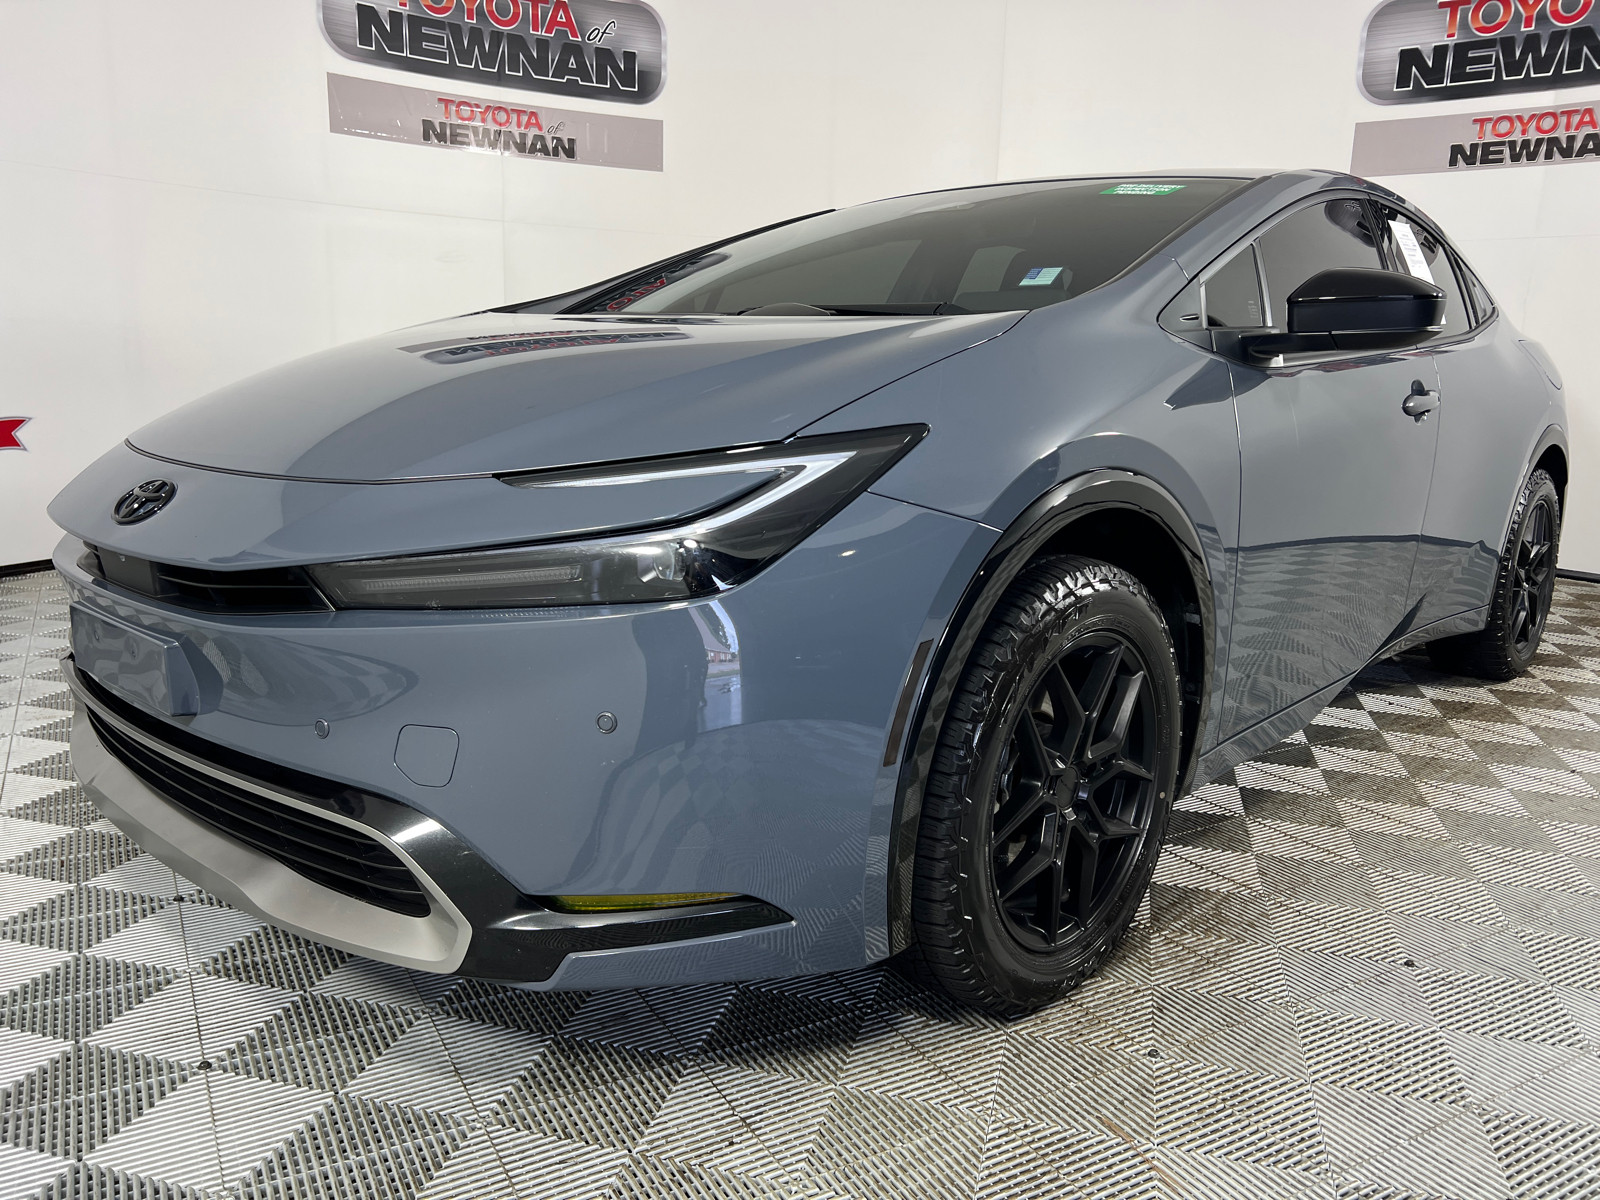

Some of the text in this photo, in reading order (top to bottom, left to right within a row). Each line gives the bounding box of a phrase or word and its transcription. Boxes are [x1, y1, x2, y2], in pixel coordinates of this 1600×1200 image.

[397, 0, 617, 44] YOTA of
[356, 2, 639, 91] NEWNAN
[437, 97, 566, 135] TOYOTA of
[1472, 106, 1599, 140] TOYOTA
[421, 118, 577, 160] NEWNAN
[1447, 131, 1600, 168] NEWNA
